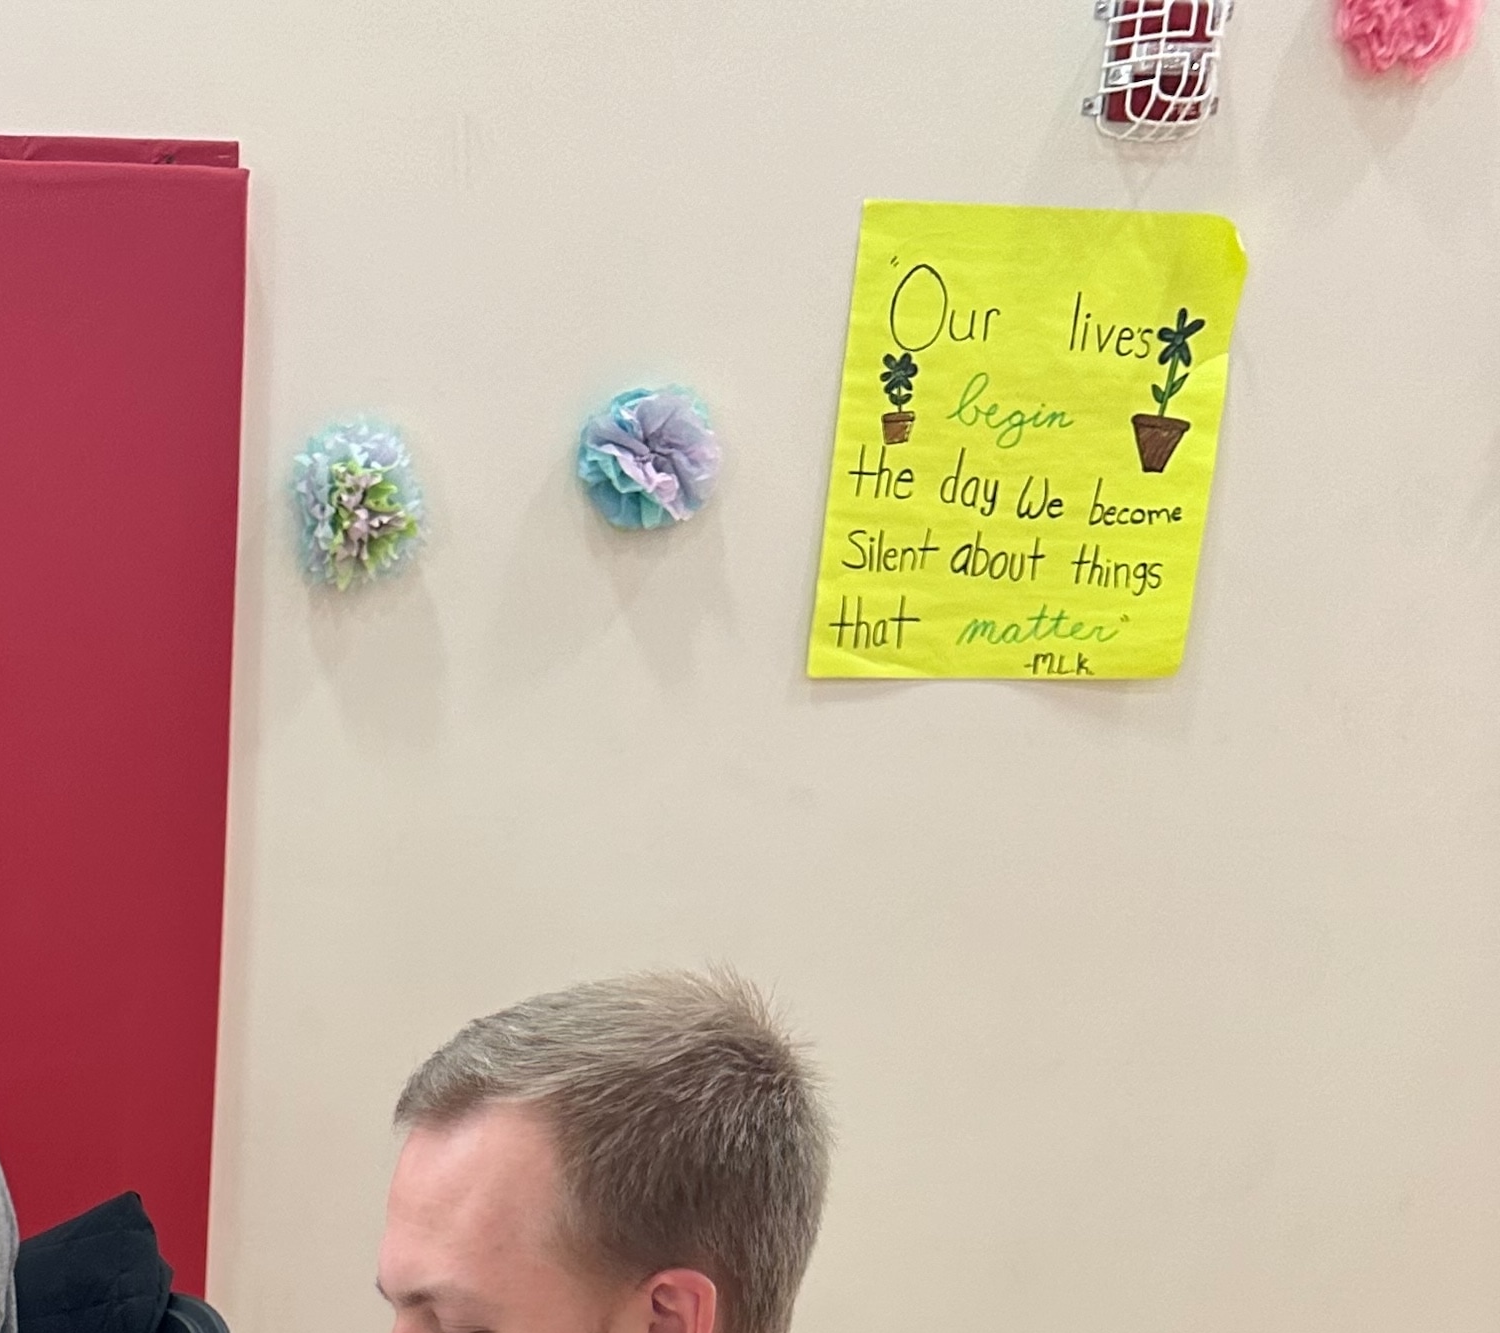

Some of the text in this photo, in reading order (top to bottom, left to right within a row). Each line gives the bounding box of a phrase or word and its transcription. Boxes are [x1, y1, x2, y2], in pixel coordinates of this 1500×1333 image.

[947, 373, 1073, 448] begin
[849, 445, 1183, 526] the day We become
[841, 528, 1163, 596] Silent about things
[829, 595, 921, 649] that
